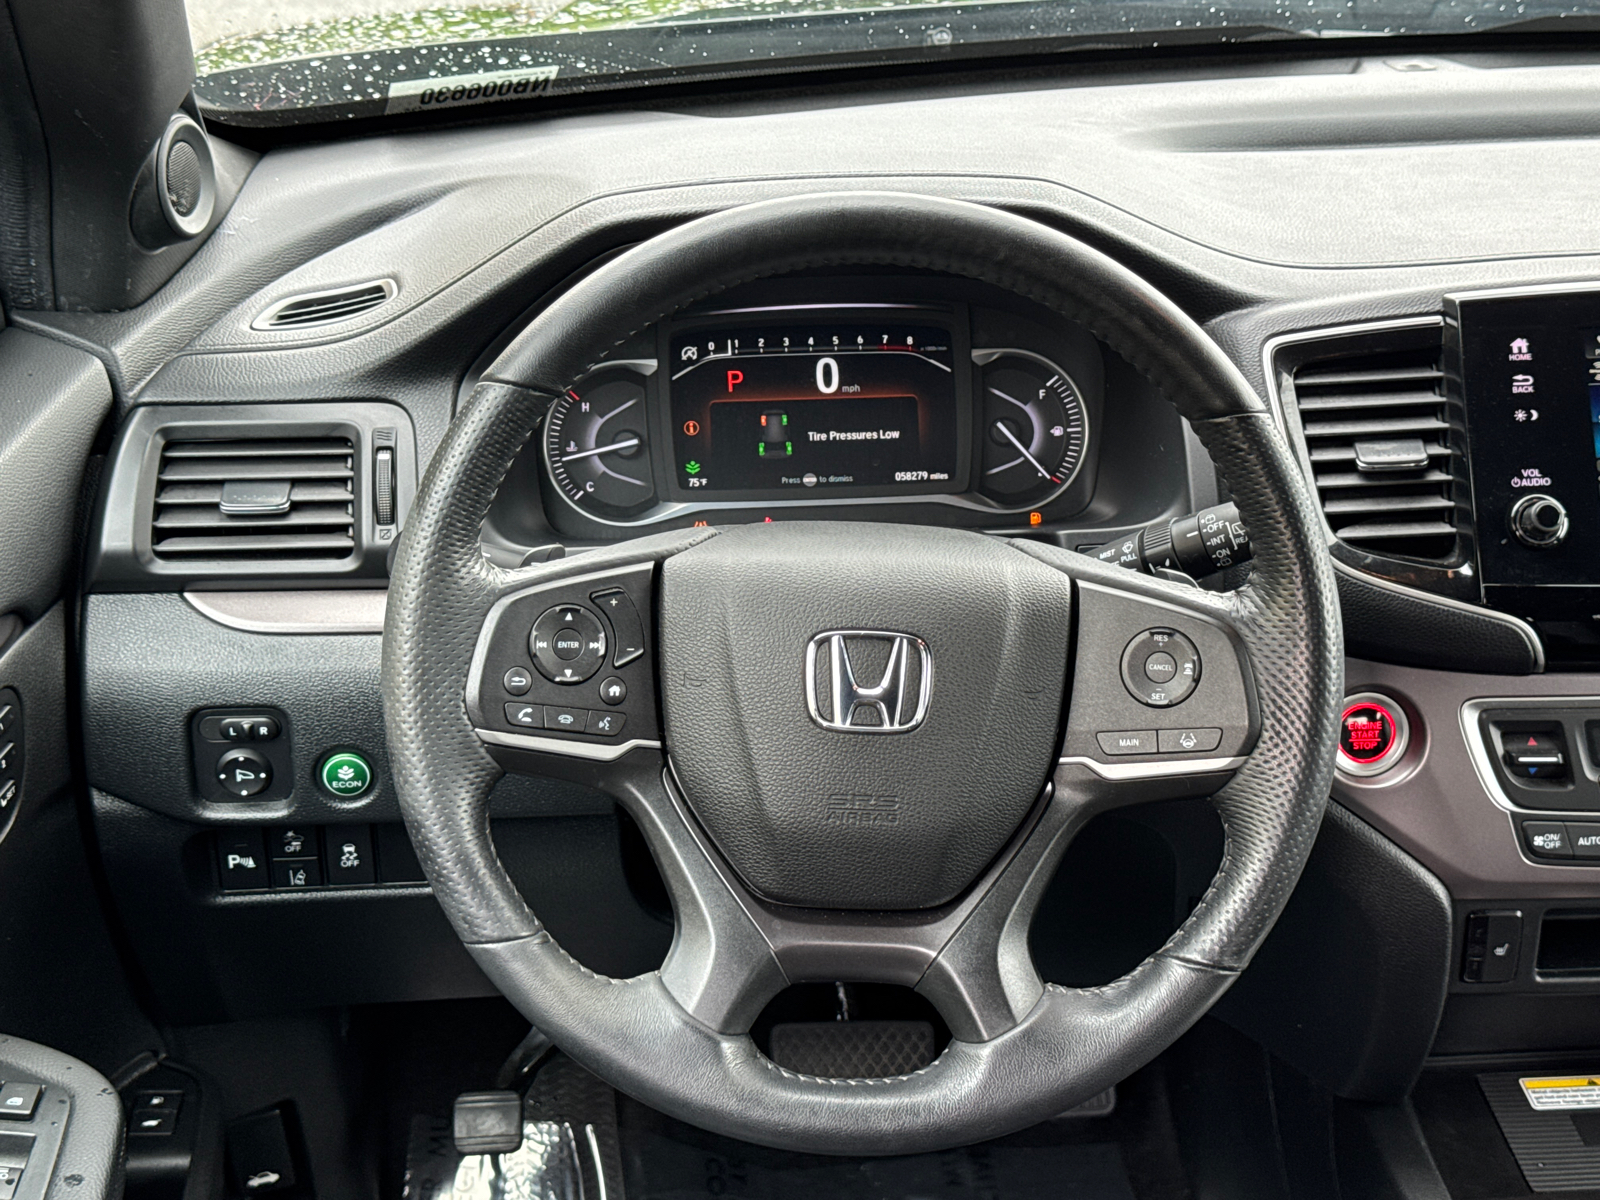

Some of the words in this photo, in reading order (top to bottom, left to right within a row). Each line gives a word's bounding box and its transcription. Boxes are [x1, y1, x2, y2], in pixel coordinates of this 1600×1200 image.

[708, 342, 715, 351] 0
[734, 339, 739, 348] 1
[758, 338, 765, 347] 2
[783, 338, 789, 346] 3
[807, 337, 815, 345] 4
[832, 336, 839, 345] 5
[857, 335, 864, 344] 6
[882, 335, 889, 344] 7
[906, 336, 914, 345] 8
[1508, 353, 1533, 361] HOME
[815, 357, 840, 394] 0
[842, 384, 861, 394] mph
[727, 370, 744, 392] P
[1039, 389, 1046, 400] F
[1512, 385, 1534, 394] BACK
[581, 402, 590, 412] H
[808, 431, 827, 442] Tire
[829, 430, 878, 441] Pressures
[880, 429, 900, 439] Low
[895, 471, 928, 482] 058279
[930, 472, 949, 480] miles
[1521, 468, 1542, 477] VOL
[781, 476, 801, 485] Press
[819, 475, 827, 483] to
[828, 474, 853, 483] dismiss
[1521, 477, 1552, 487] AUDIO
[585, 481, 595, 493] C
[1207, 520, 1225, 533] OFF
[1210, 533, 1226, 547] INT
[1099, 548, 1116, 560] MIST
[1120, 553, 1137, 563] PULL
[1215, 547, 1231, 559] ON
[1153, 634, 1169, 642] RES
[557, 640, 580, 650] ENTER
[1149, 663, 1173, 672] CANCEL
[1151, 692, 1166, 701] SET
[1348, 720, 1382, 731] ENGINE
[229, 726, 237, 737] L
[259, 726, 269, 736] R
[1350, 730, 1380, 739] START
[1119, 738, 1140, 747] MAIN
[1352, 741, 1379, 751] STOP
[331, 780, 363, 789] ECON
[826, 812, 899, 824] AIRBAG
[1543, 833, 1561, 841] ON/
[284, 845, 302, 853] OFF
[1543, 841, 1562, 849] OFF
[340, 859, 360, 868] OFF
